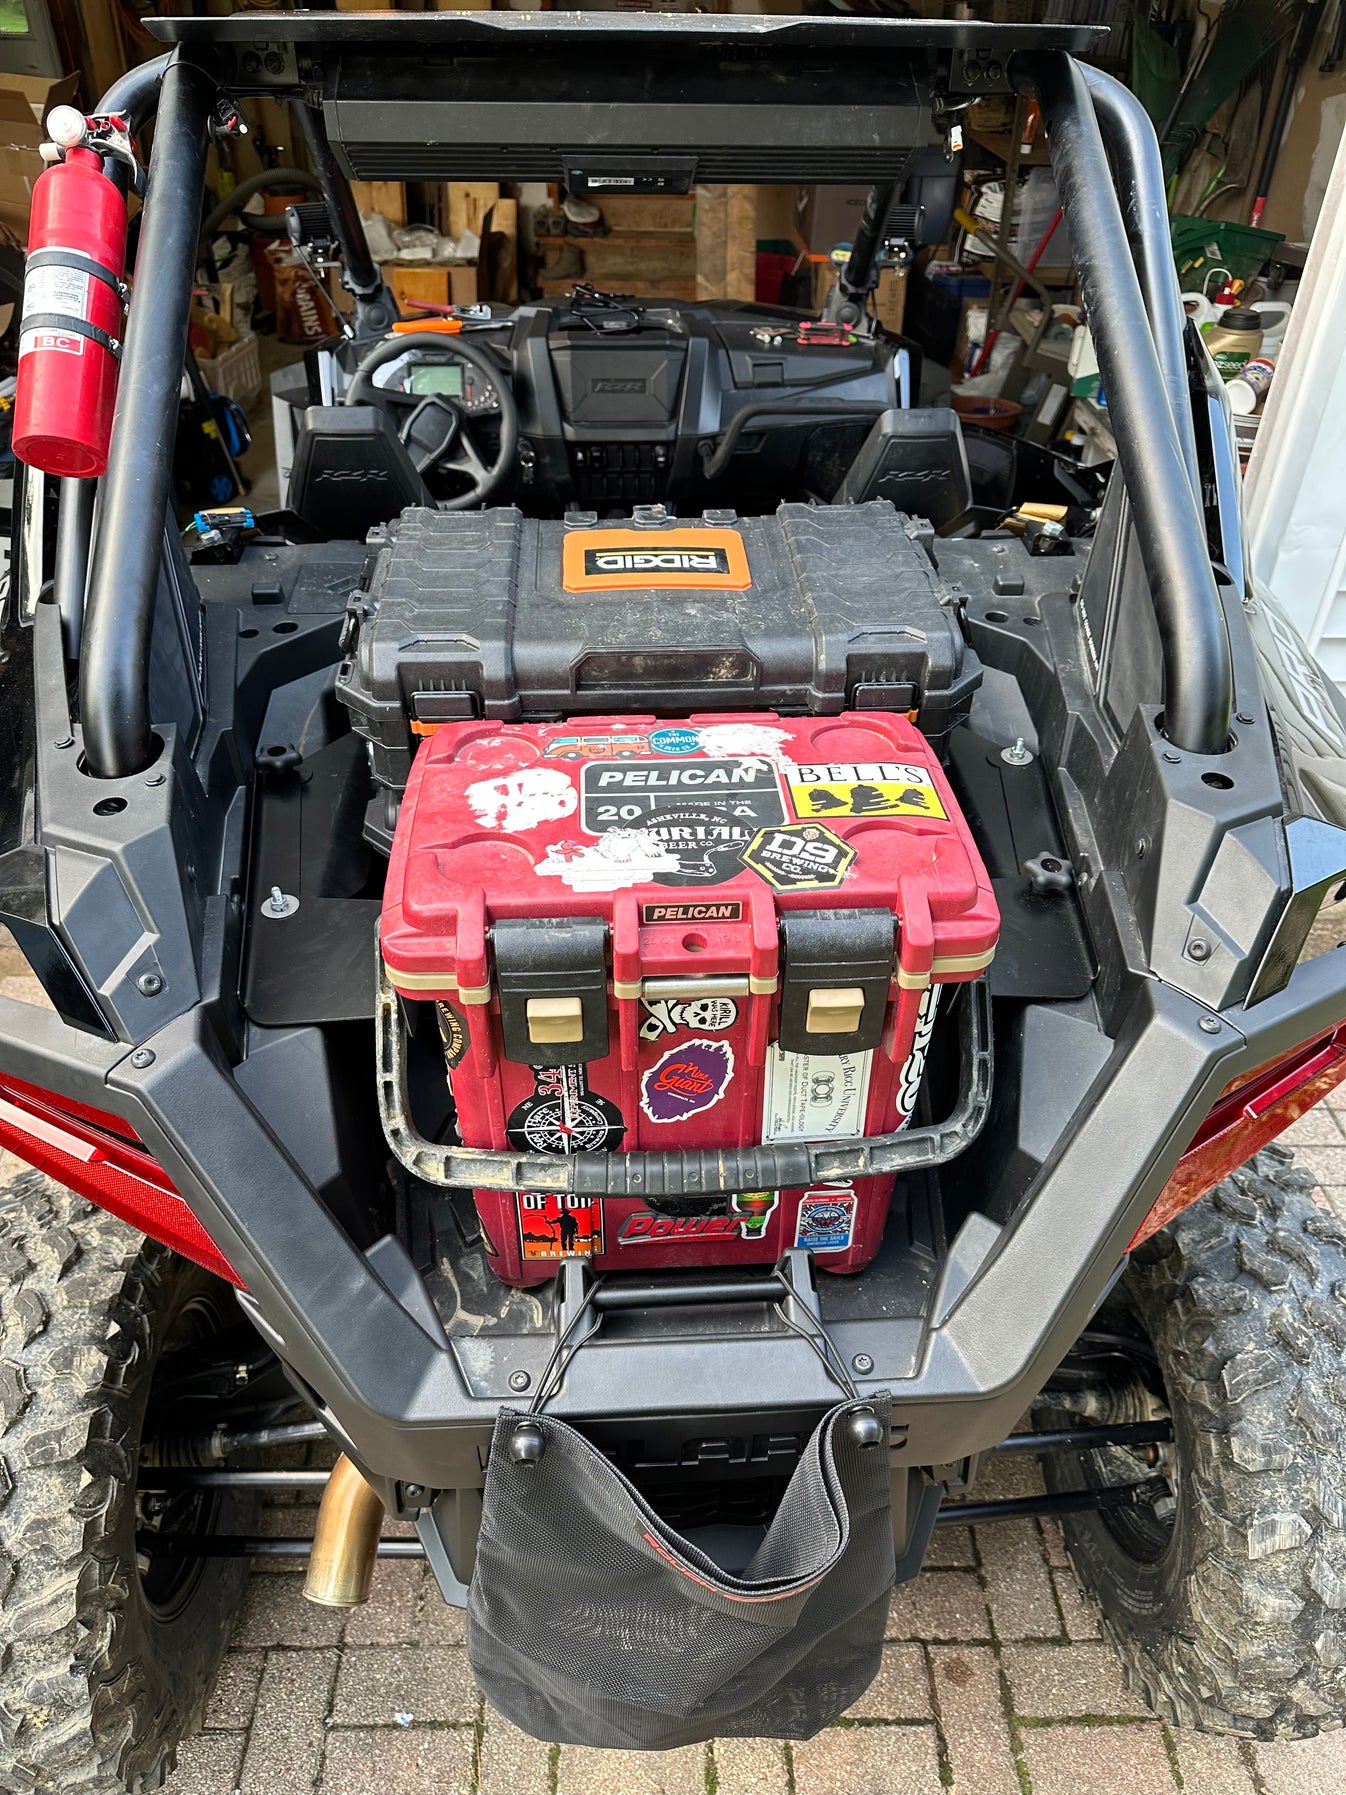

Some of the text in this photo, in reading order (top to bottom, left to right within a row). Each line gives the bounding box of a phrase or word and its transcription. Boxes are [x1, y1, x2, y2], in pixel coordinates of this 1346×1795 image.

[42, 336, 71, 348] BC
[315, 469, 388, 482] RZR
[878, 469, 951, 482] RZR
[595, 554, 718, 569] RIDGID
[652, 735, 700, 745] COMMON
[597, 768, 757, 787] PELICAN
[800, 766, 925, 784] BELL'S
[596, 805, 643, 821] 20
[711, 816, 728, 824] NC
[648, 826, 750, 841] URIAL
[661, 841, 698, 849] BEER
[765, 832, 839, 864] D9
[760, 850, 830, 874] BREWING
[653, 905, 733, 920] PELICAN
[438, 1000, 462, 1033] REWING
[708, 1000, 719, 1028] WAS HERE
[718, 1002, 732, 1026] KIRILL
[801, 1081, 809, 1098] DUCT
[526, 1107, 550, 1150] Red Hare
[522, 1194, 546, 1209] OF
[621, 1213, 751, 1239] Power
